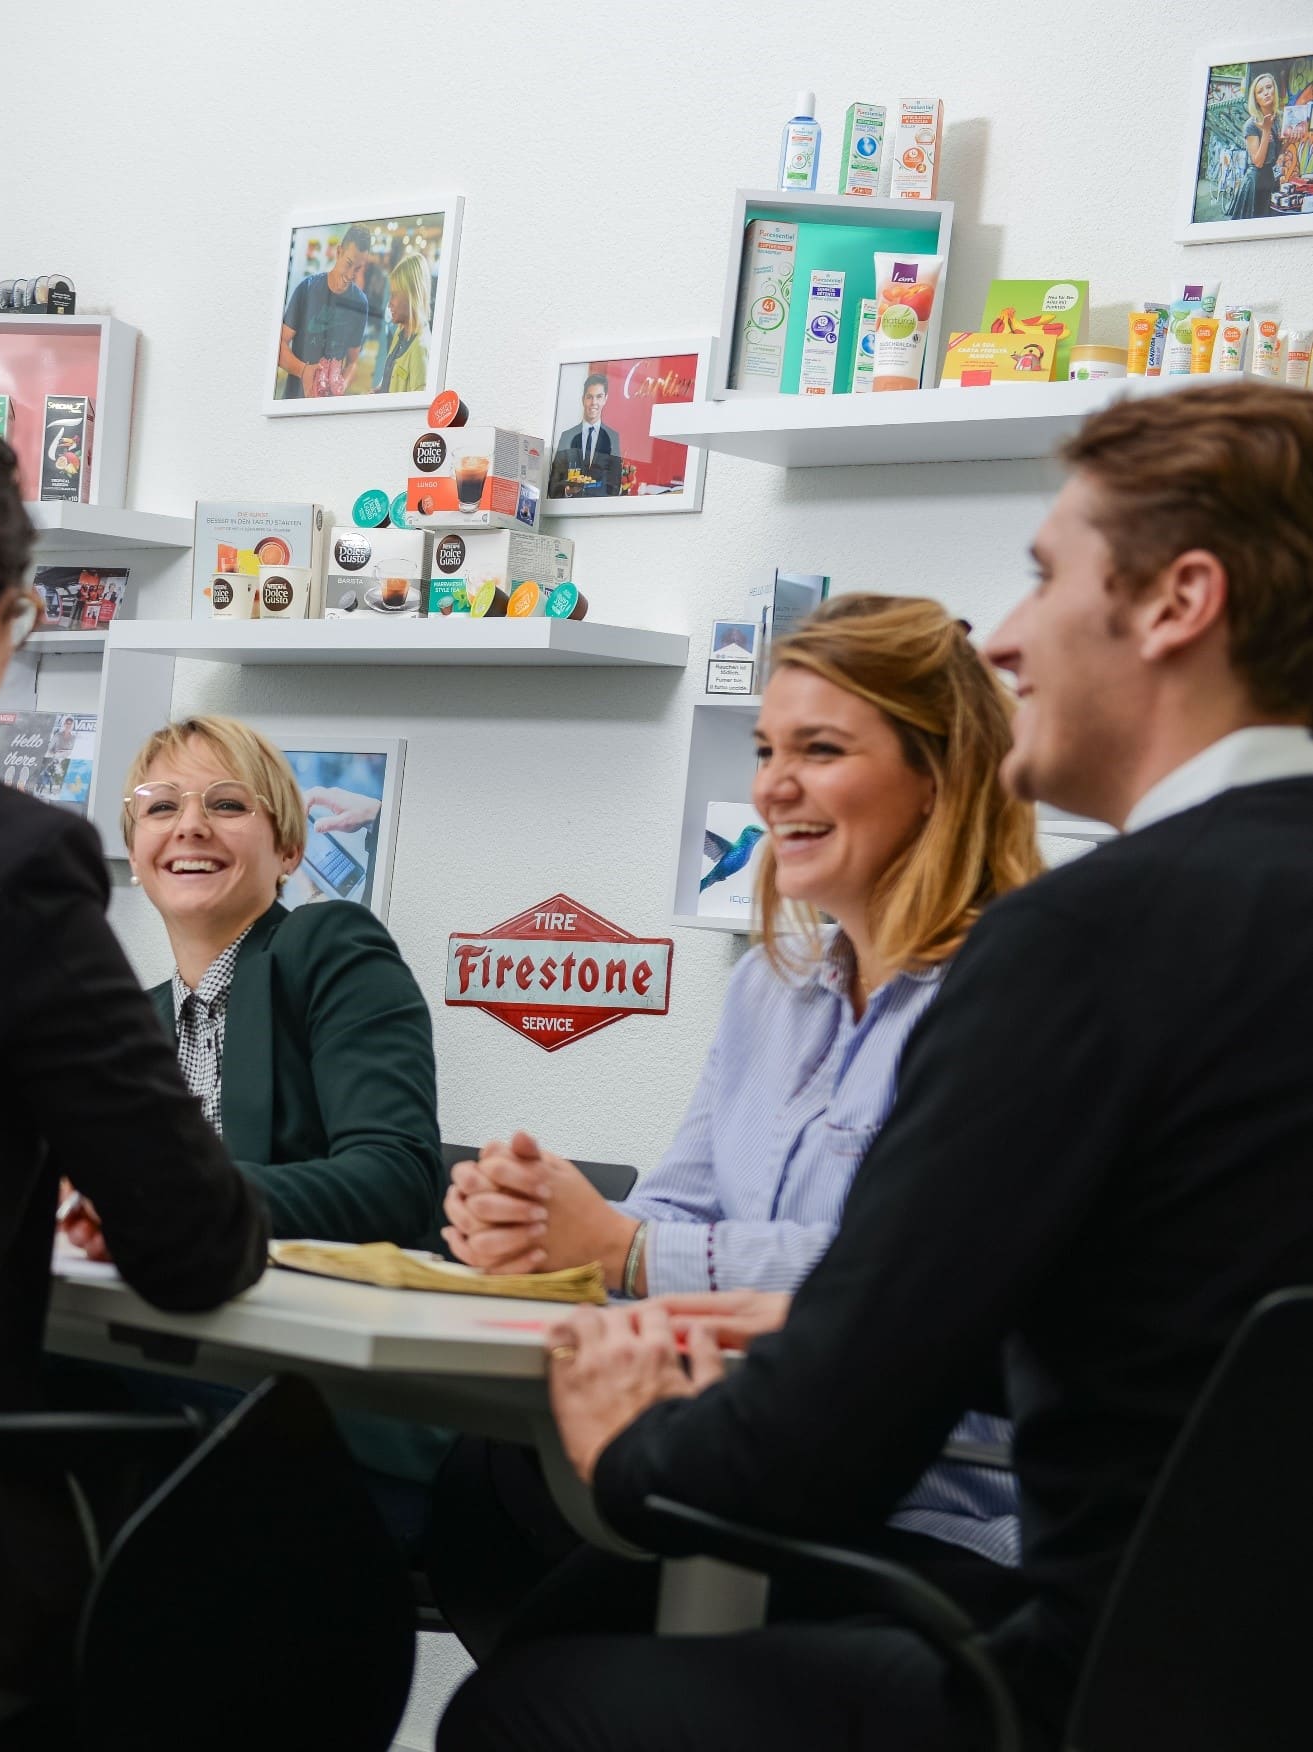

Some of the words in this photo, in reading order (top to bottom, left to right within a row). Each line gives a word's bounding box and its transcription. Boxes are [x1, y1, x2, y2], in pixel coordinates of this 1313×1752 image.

[417, 447, 442, 457] Dolce
[417, 455, 441, 464] Gusto
[440, 548, 462, 558] Dolce
[439, 557, 461, 566] Gusto
[265, 588, 288, 598] Dolce
[265, 596, 288, 604] Gusto
[11, 733, 43, 748] Hello
[4, 751, 38, 767] there.
[729, 895, 751, 904] IQO
[534, 913, 577, 931] TIRE
[455, 944, 653, 995] Firestone
[522, 1016, 574, 1032] SERVICE
